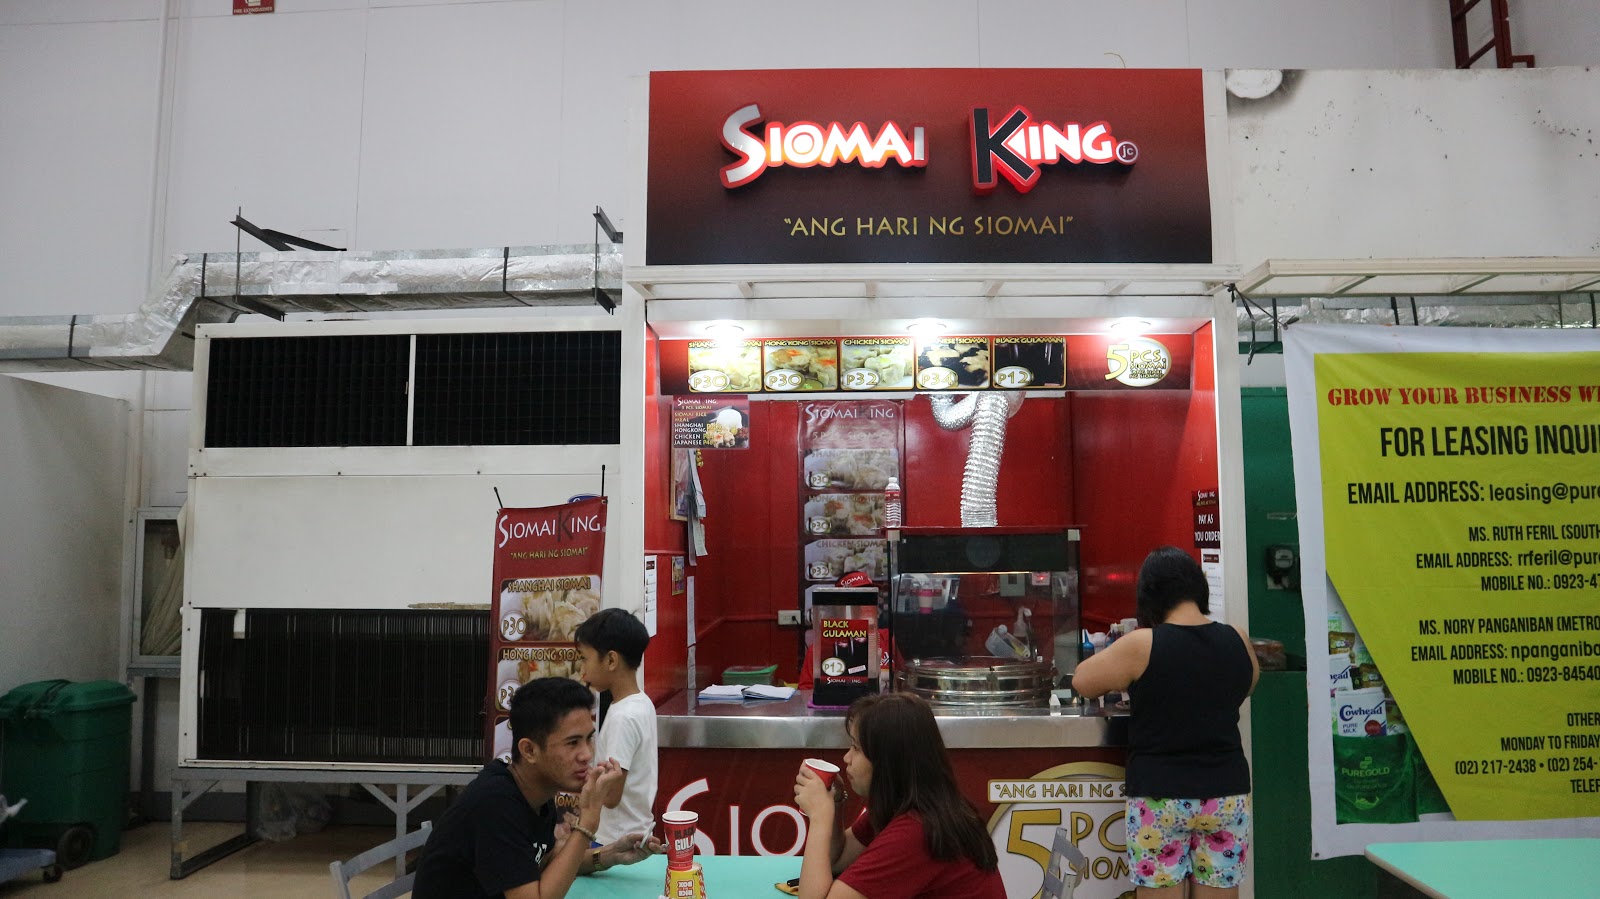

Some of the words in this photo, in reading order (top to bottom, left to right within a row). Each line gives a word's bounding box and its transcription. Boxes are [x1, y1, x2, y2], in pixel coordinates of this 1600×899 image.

[720, 103, 928, 188] SIOMAI
[971, 104, 1115, 193] KING
[856, 216, 919, 236] HARI
[928, 216, 965, 236] NG
[1104, 344, 1129, 380] 5
[693, 375, 728, 389] P30
[768, 373, 802, 387] P30
[846, 373, 880, 386] P32
[921, 373, 953, 386] P34
[998, 371, 1029, 385] P12
[1327, 387, 1392, 406] GROW
[1398, 386, 1459, 405] YOUR
[1463, 385, 1572, 405] BUSINESS
[804, 403, 857, 424] SIOMAI
[1380, 426, 1426, 457] FOR
[1431, 424, 1529, 456] LEASING
[1534, 424, 1600, 455] INQUI
[1347, 482, 1400, 505] EMAIL
[1403, 480, 1485, 502] ADDRESS:
[1198, 514, 1207, 525] PAY
[1207, 514, 1213, 524] AS
[1194, 531, 1204, 541] YOU
[1204, 530, 1220, 541] ORDER
[1468, 526, 1490, 541] MS.
[1492, 526, 1524, 541] RUTH
[1526, 525, 1559, 540] FERIL
[815, 540, 854, 548] CHICKEN
[529, 550, 546, 559] HARI
[548, 549, 559, 558] NG
[1416, 553, 1453, 568] EMAIL
[1456, 551, 1513, 568] ADDRESS:
[1518, 549, 1600, 569] rrferil@pur
[507, 578, 555, 593] SHANGHAI
[555, 576, 592, 591] SIOMAI
[1480, 575, 1525, 591] MOBILE
[1527, 574, 1551, 590] NO.:
[502, 616, 527, 636] P30
[823, 620, 849, 628] BLACK
[1419, 619, 1441, 635] MS.
[1443, 618, 1475, 635] NORY
[1478, 616, 1554, 634] PANGANIBAN
[822, 629, 867, 638] GULAMAN
[502, 648, 530, 661] HONG
[531, 648, 557, 661] KONG
[1411, 645, 1448, 662] EMAIL
[1450, 643, 1508, 661] ADDRESS:
[824, 661, 844, 674] P12
[1453, 668, 1498, 684] MOBILE
[1500, 667, 1524, 683] NO.:
[1339, 704, 1383, 721] Cowhead
[1567, 712, 1600, 727] OTHER
[1500, 736, 1545, 751] MONDAY
[1547, 735, 1561, 749] TO
[1564, 734, 1600, 749] FRIDAY
[1341, 766, 1391, 777] PUREGOLD
[1455, 760, 1479, 774] (02)
[1481, 759, 1537, 774] 217-2438
[1547, 758, 1570, 772] (02)
[1573, 756, 1600, 772] 254-
[1042, 784, 1084, 798] HARI
[1089, 784, 1114, 798] NG
[1070, 810, 1127, 852] PC
